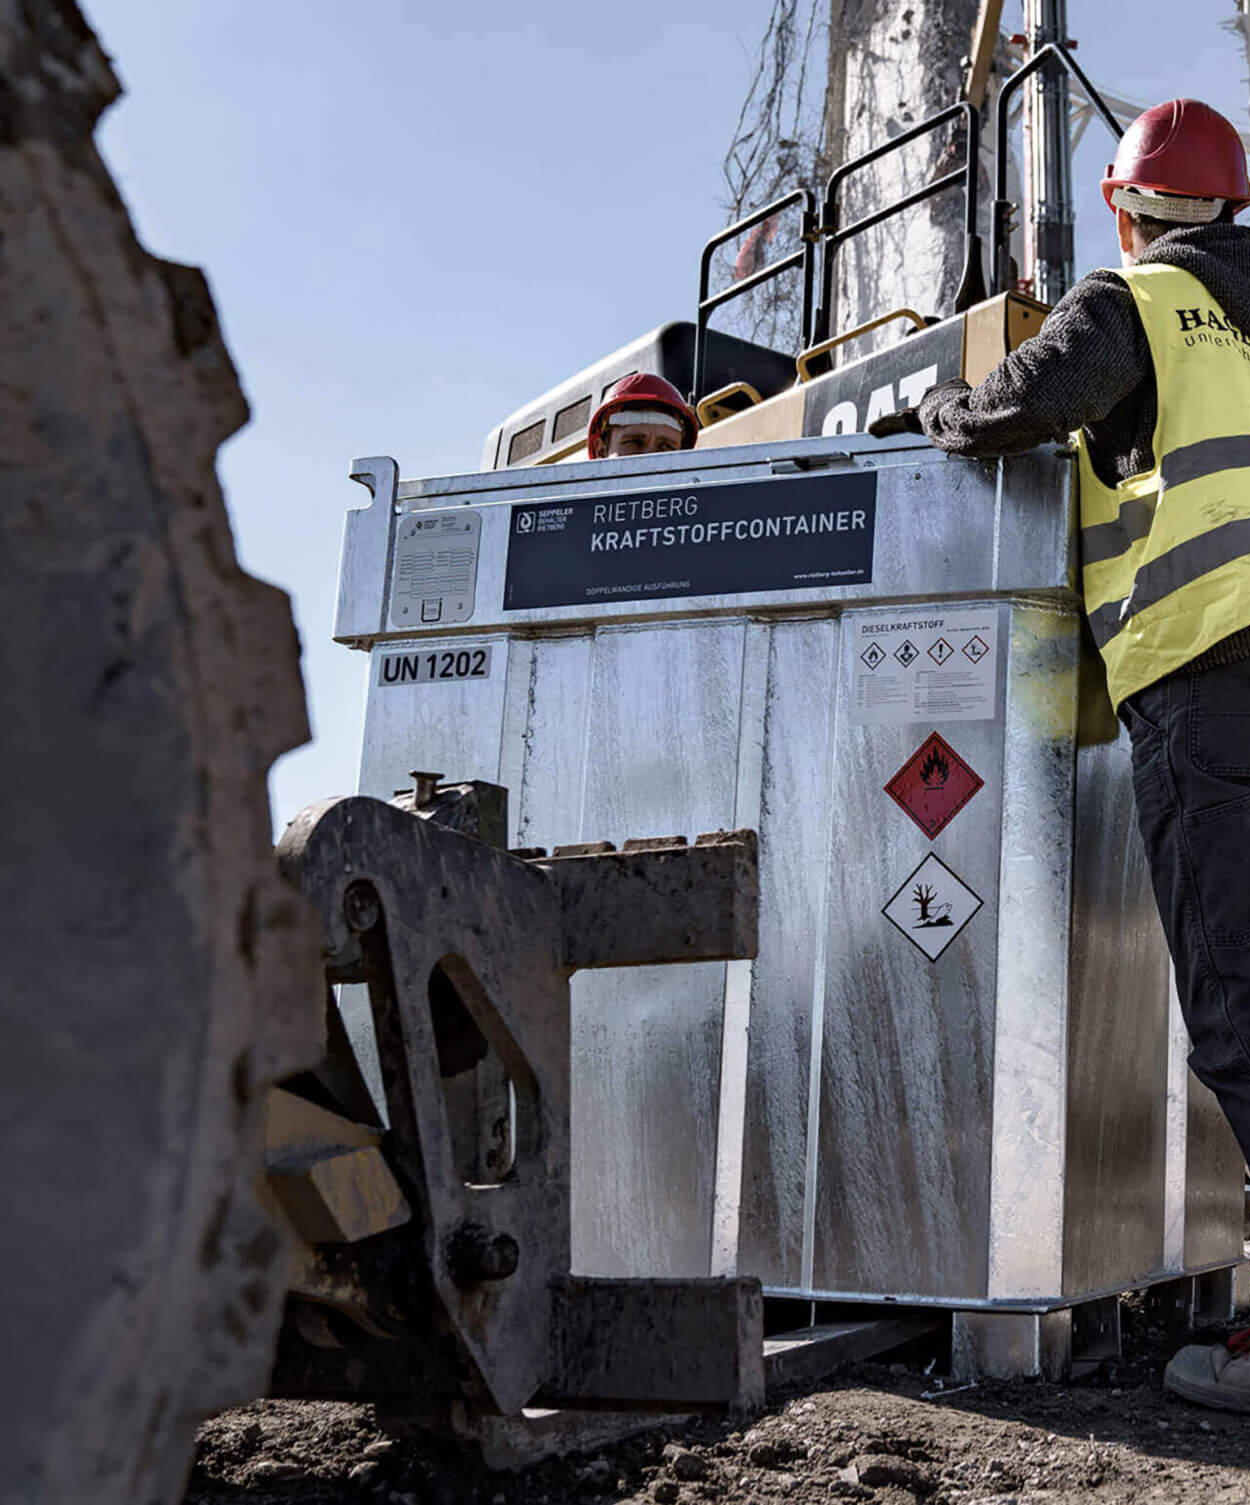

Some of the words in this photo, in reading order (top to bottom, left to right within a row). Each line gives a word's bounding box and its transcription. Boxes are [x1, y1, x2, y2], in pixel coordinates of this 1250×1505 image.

[593, 495, 699, 525] RIETBERG
[590, 510, 867, 553] KRAFTSTOFFCONTAINER
[861, 619, 945, 634] DIESELKRAFTSTOFF
[383, 655, 419, 683] UN
[426, 649, 487, 679] 1202
